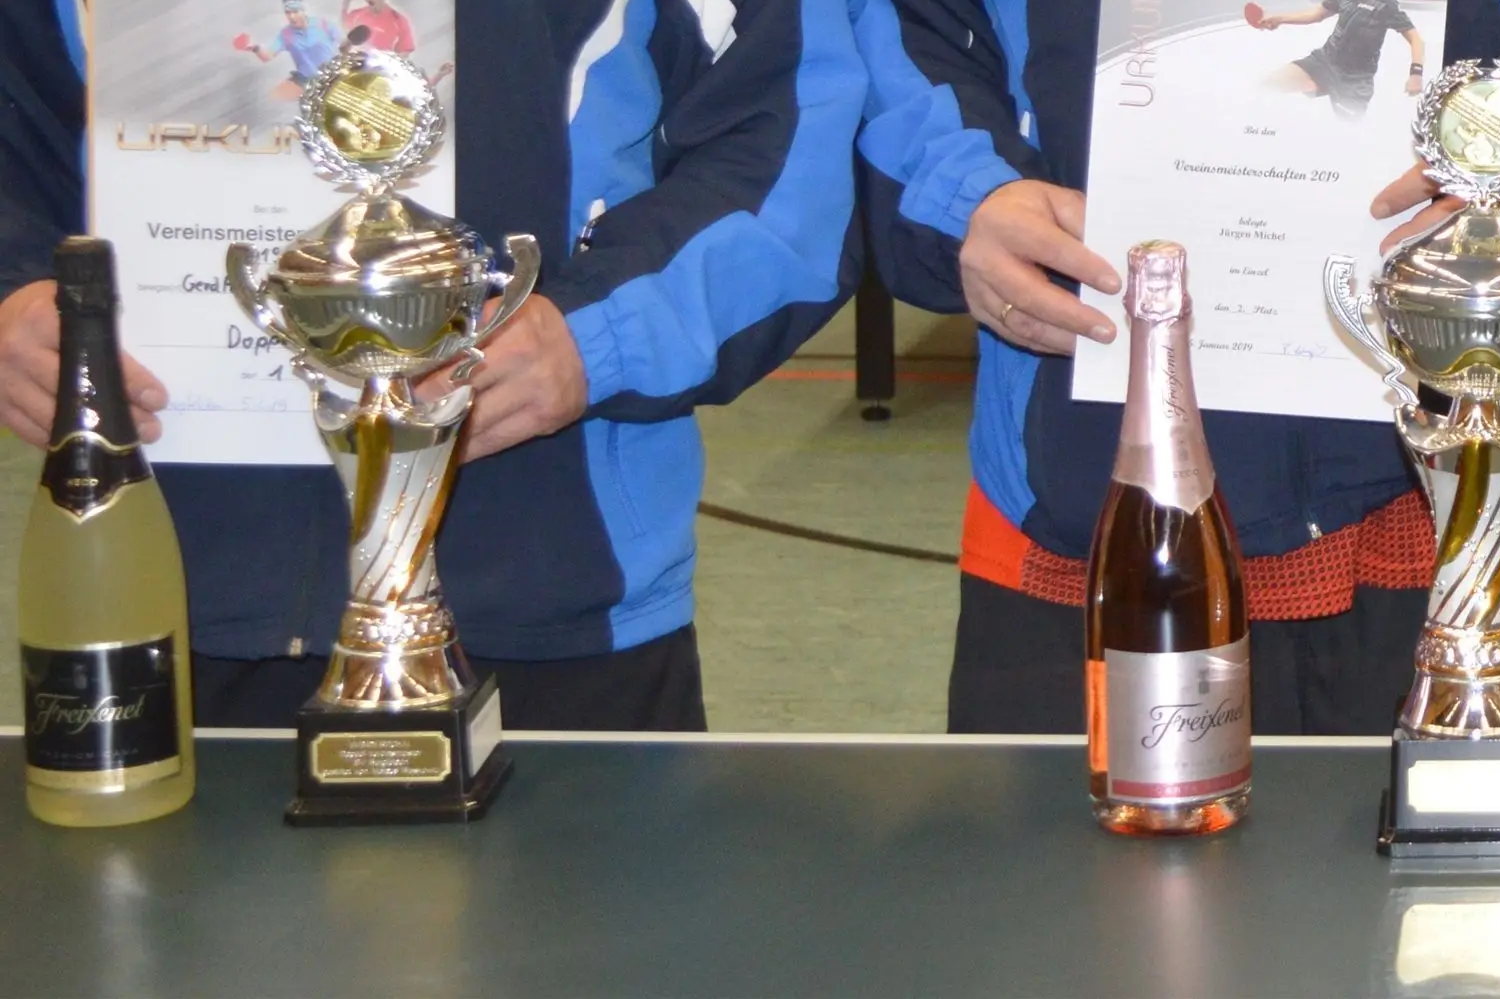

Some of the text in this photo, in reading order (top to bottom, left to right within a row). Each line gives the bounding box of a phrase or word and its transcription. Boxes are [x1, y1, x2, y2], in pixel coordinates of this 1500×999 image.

[1174, 158, 1340, 183] Vereinsmeisterschaften 2019
[1218, 227, 1286, 242] Jürgen Michel
[1231, 341, 1254, 352] 2019
[31, 692, 147, 736] Freixenet
